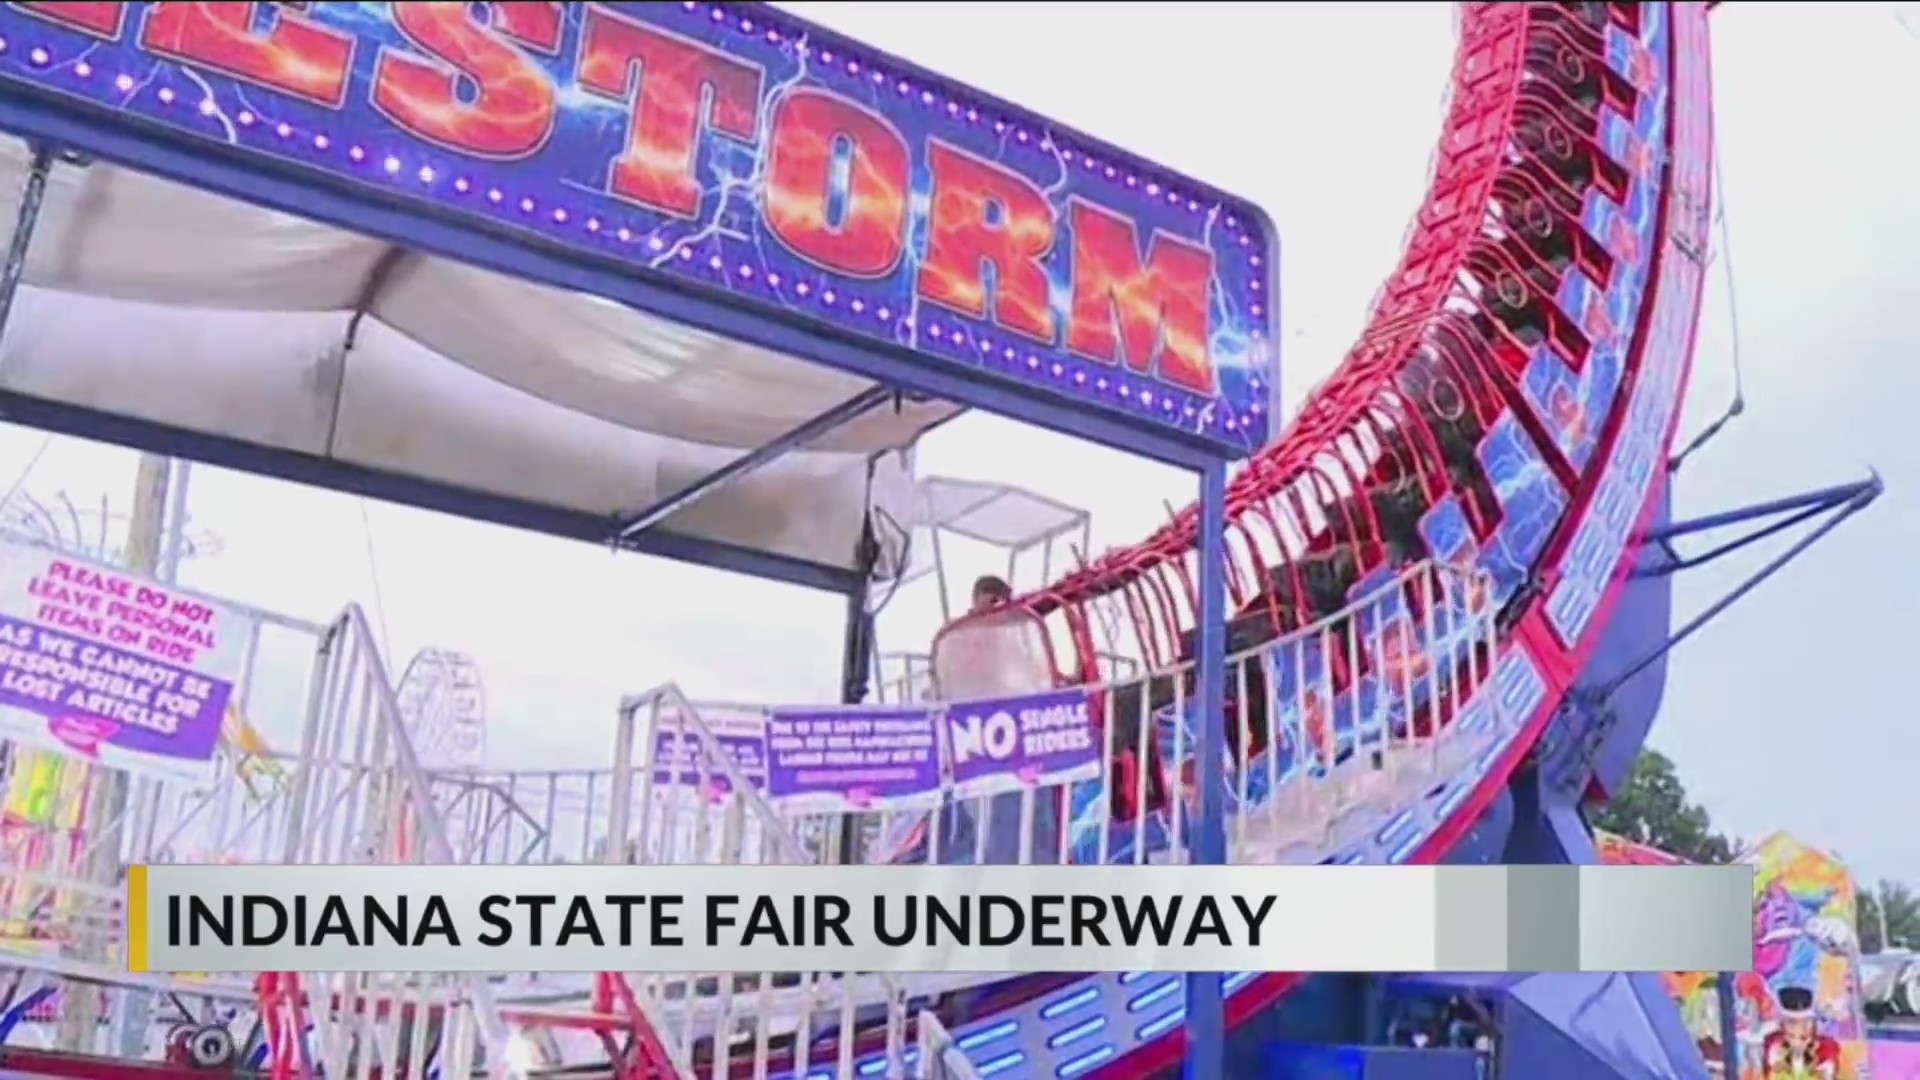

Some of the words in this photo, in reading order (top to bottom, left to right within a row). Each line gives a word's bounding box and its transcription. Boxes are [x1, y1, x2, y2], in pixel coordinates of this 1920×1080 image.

[28, 578, 101, 611] LEAVE
[107, 603, 214, 648] PERSONAL
[49, 562, 131, 595] PLEASE
[136, 586, 168, 609] DO
[171, 600, 215, 624] NOT
[0, 623, 33, 646] AS
[39, 631, 77, 659] WE
[80, 646, 179, 689] CANNOT
[182, 676, 212, 698] BE
[37, 603, 101, 635] ITEMS
[107, 624, 141, 643] ON
[147, 635, 196, 663] RIDE
[3, 670, 65, 701] LOST
[66, 690, 180, 735] ARTICLES
[154, 689, 202, 718] FOR
[1020, 703, 1089, 731] SINGLE
[951, 711, 1017, 764] NO
[1023, 727, 1092, 757] RIDERS
